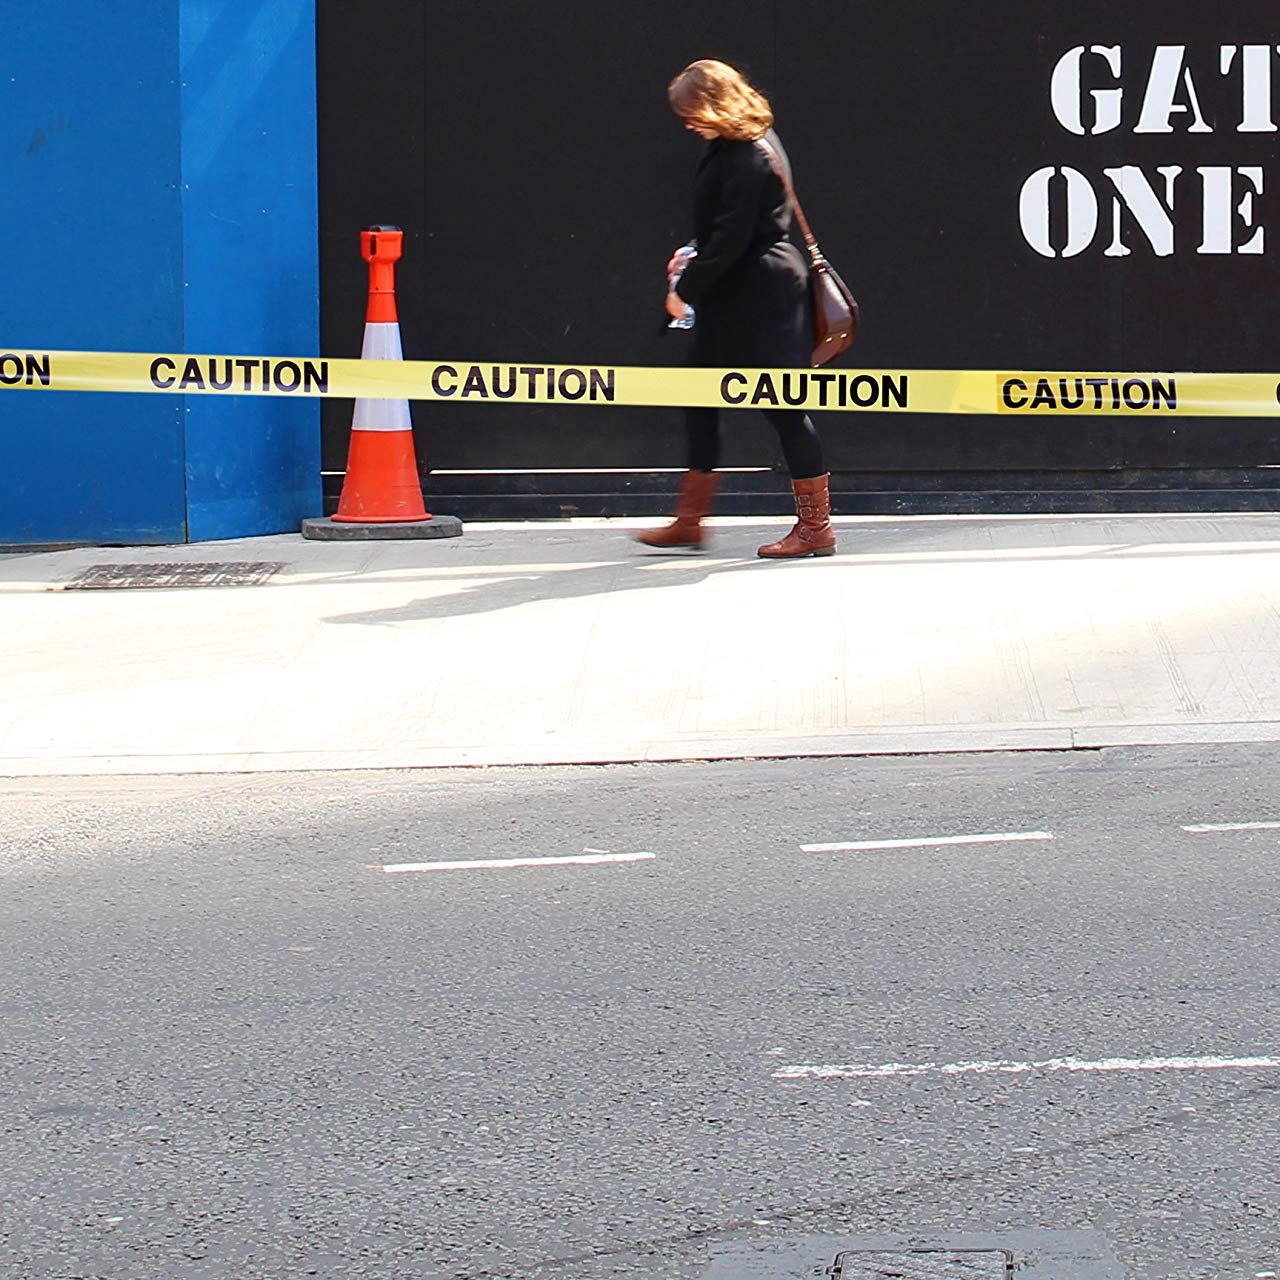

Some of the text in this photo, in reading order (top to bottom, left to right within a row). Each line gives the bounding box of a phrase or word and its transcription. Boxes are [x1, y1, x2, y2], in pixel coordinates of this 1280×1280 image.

[1019, 165, 1265, 258] ONE
[150, 357, 329, 393] CAUTION
[431, 364, 615, 401] CAUTION
[720, 372, 909, 408] CAUTION
[1002, 378, 1177, 410] CAUTION
